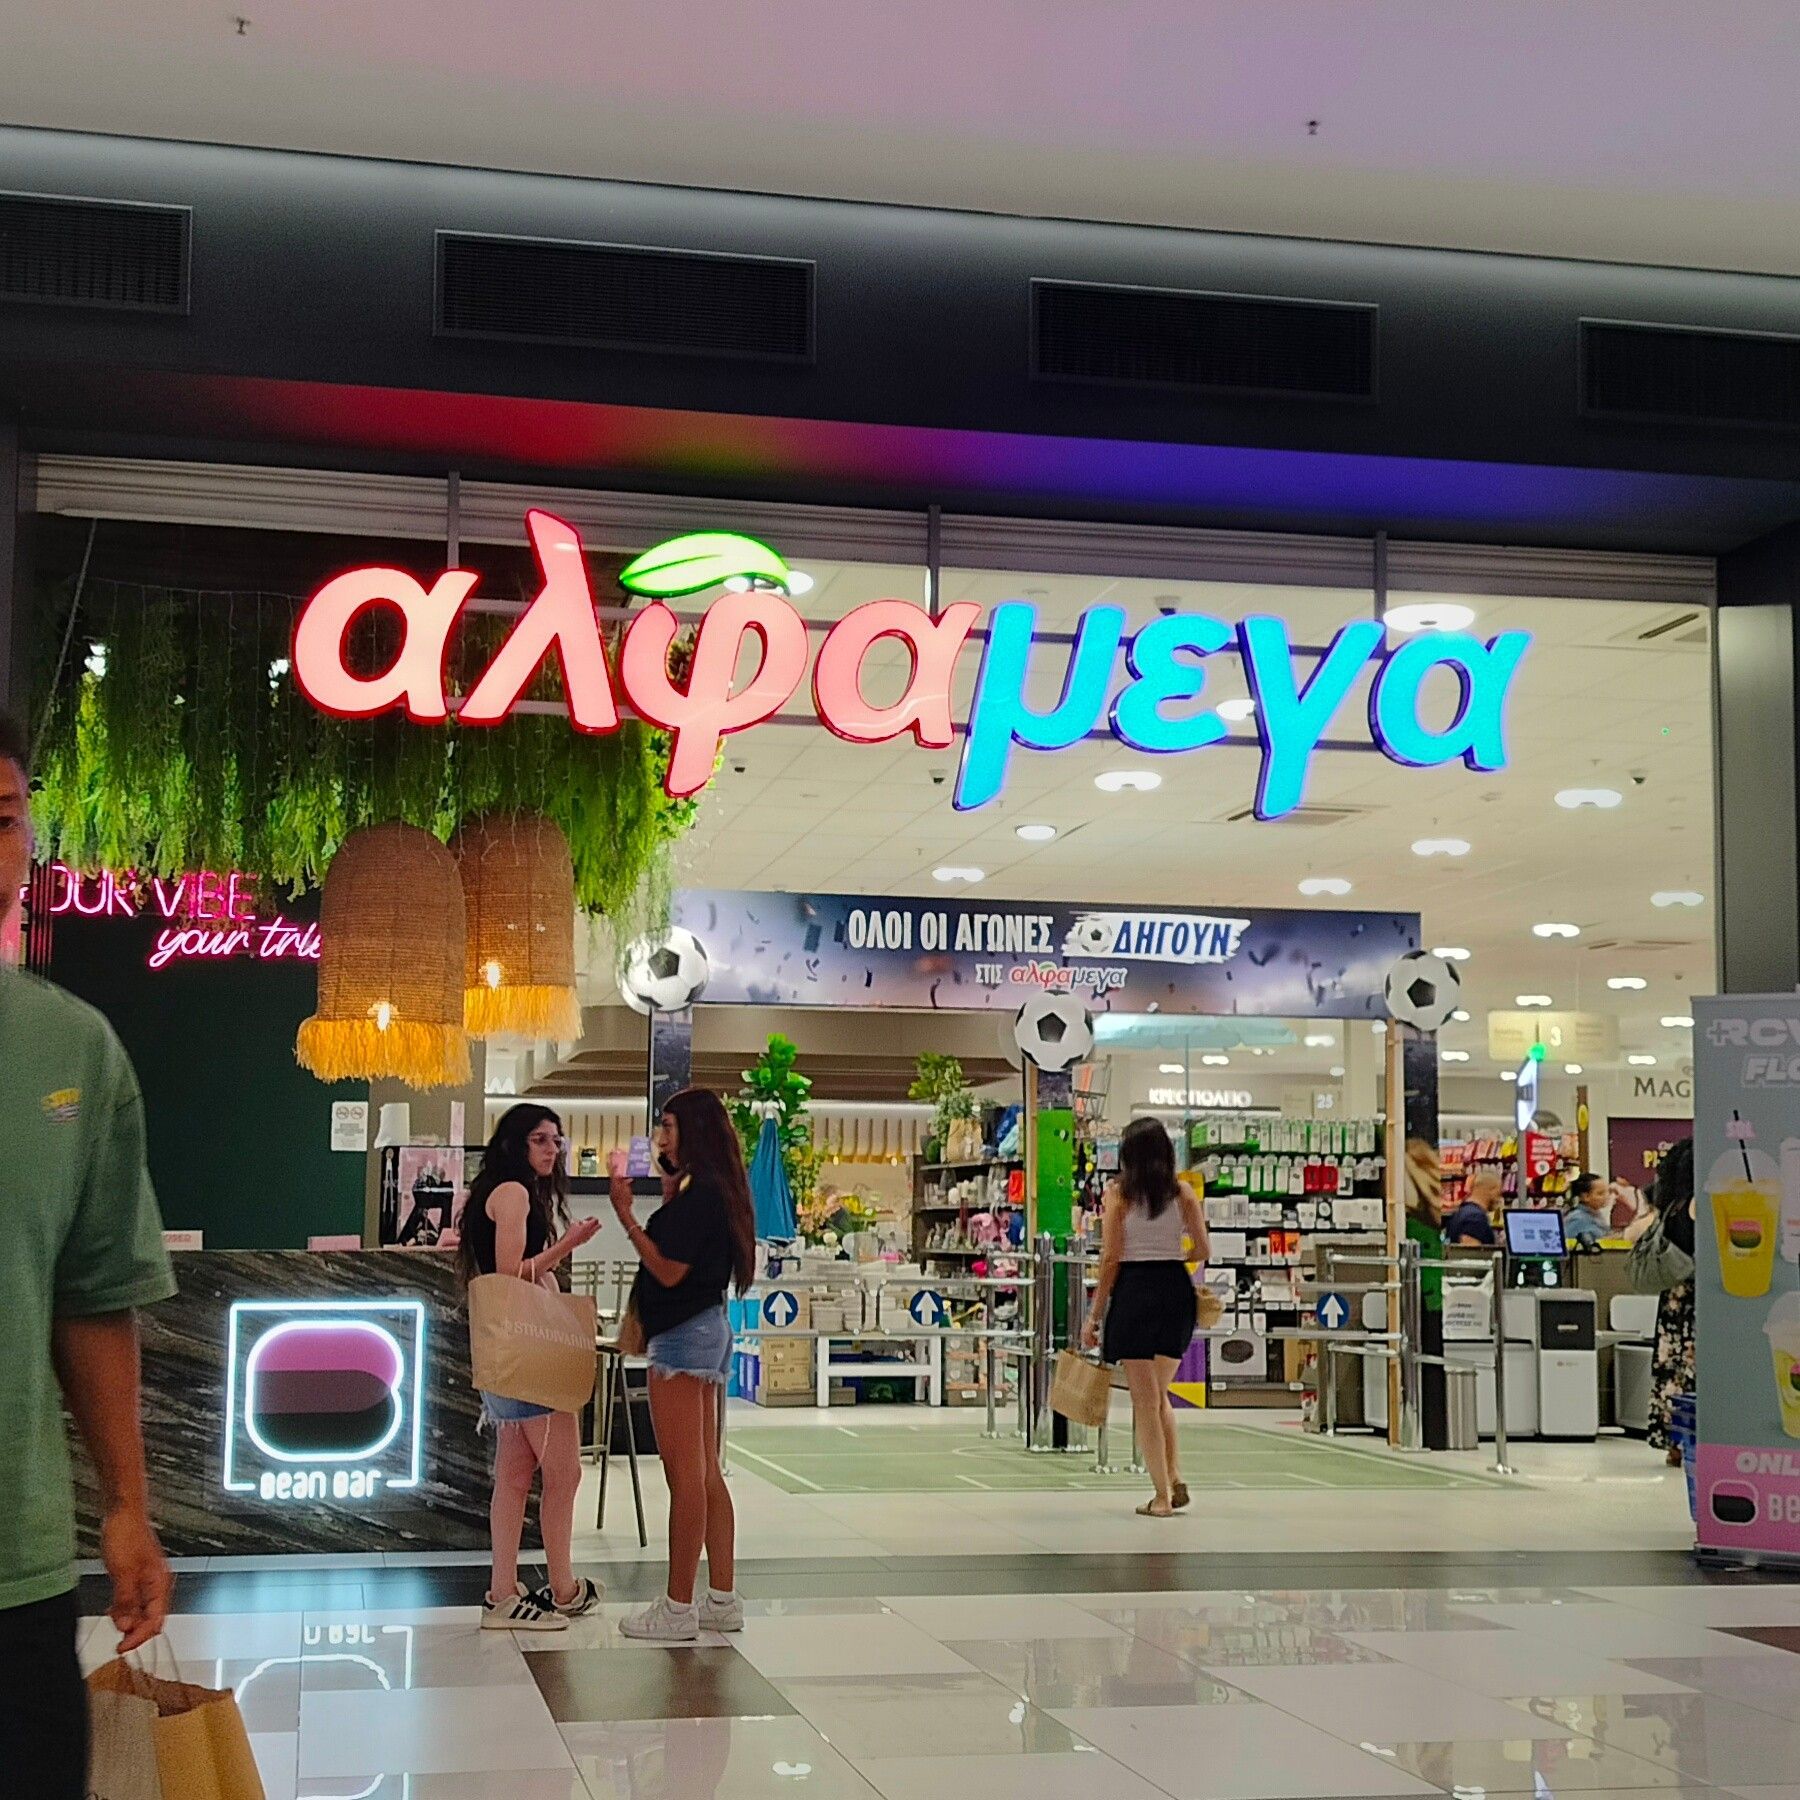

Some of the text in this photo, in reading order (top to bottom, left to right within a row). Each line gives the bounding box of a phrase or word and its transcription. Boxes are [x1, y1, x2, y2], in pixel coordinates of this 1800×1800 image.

[293, 508, 1532, 821] αλφαμεγα
[20, 865, 257, 919] OUR VIBE
[149, 928, 250, 968] your
[848, 909, 912, 949] ΟΛΟΙ
[920, 912, 948, 950] ΟΙ
[954, 913, 1055, 953] ΑΓΩΝΕΣ
[975, 960, 1126, 992] ΣΤΙΣ αλφαμεγα
[1634, 1076, 1691, 1098] MAG
